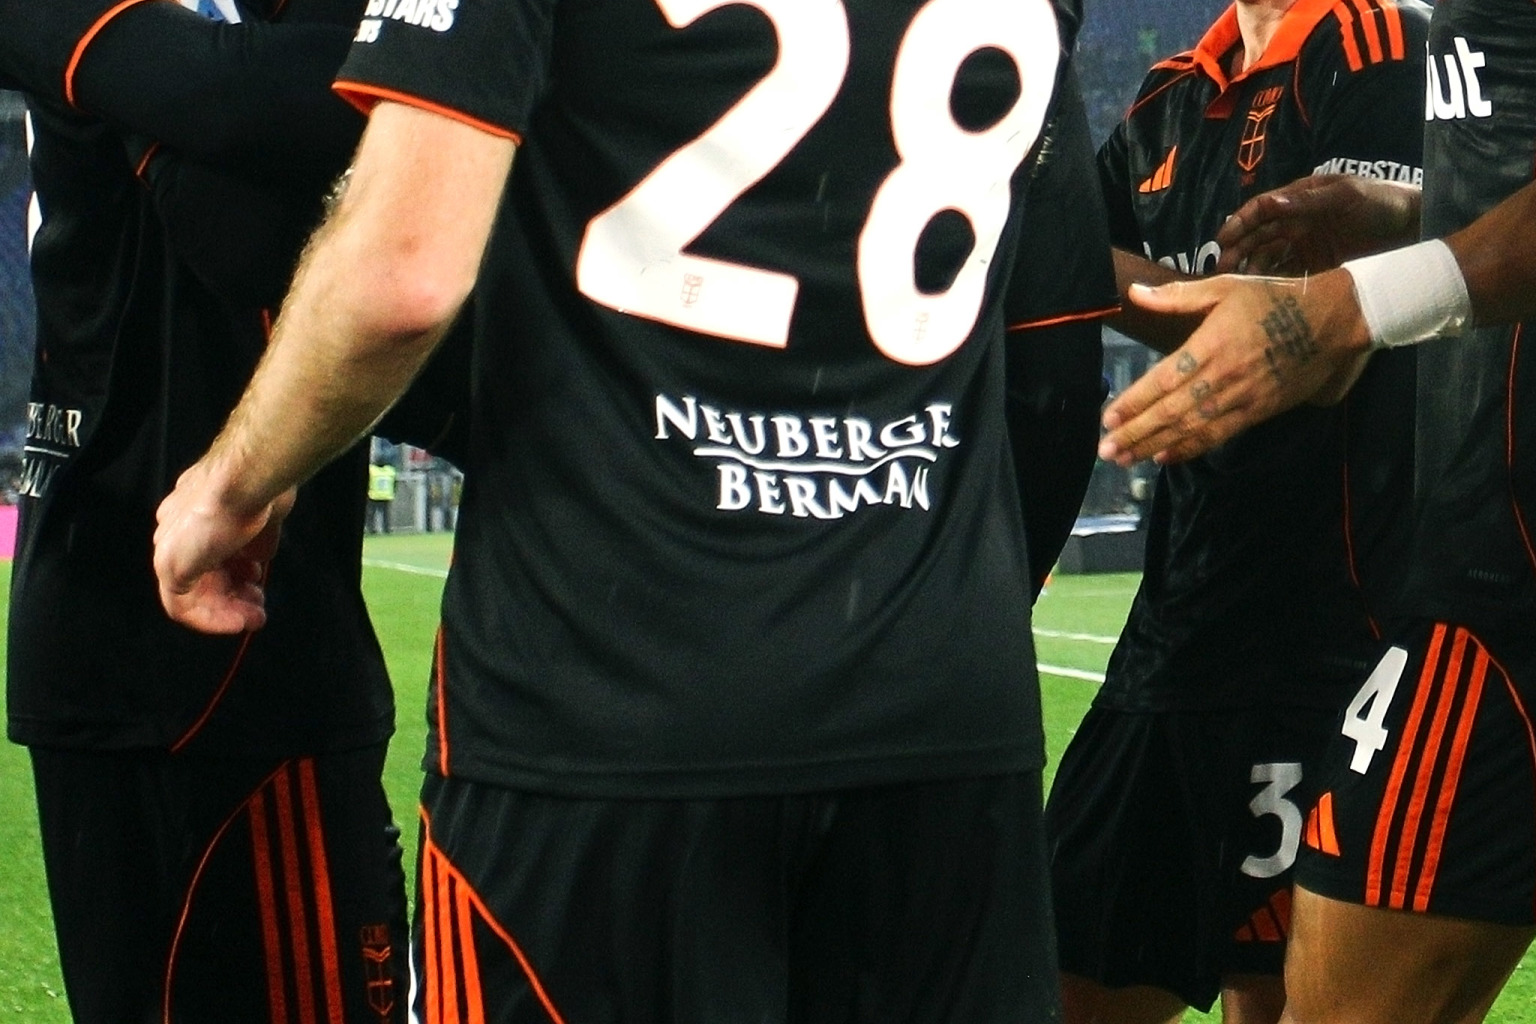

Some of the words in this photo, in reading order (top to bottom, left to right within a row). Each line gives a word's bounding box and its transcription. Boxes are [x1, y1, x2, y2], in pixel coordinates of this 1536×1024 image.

[715, 461, 930, 519] BERMAN
[1342, 645, 1408, 774] 4
[1240, 762, 1301, 878] 3
